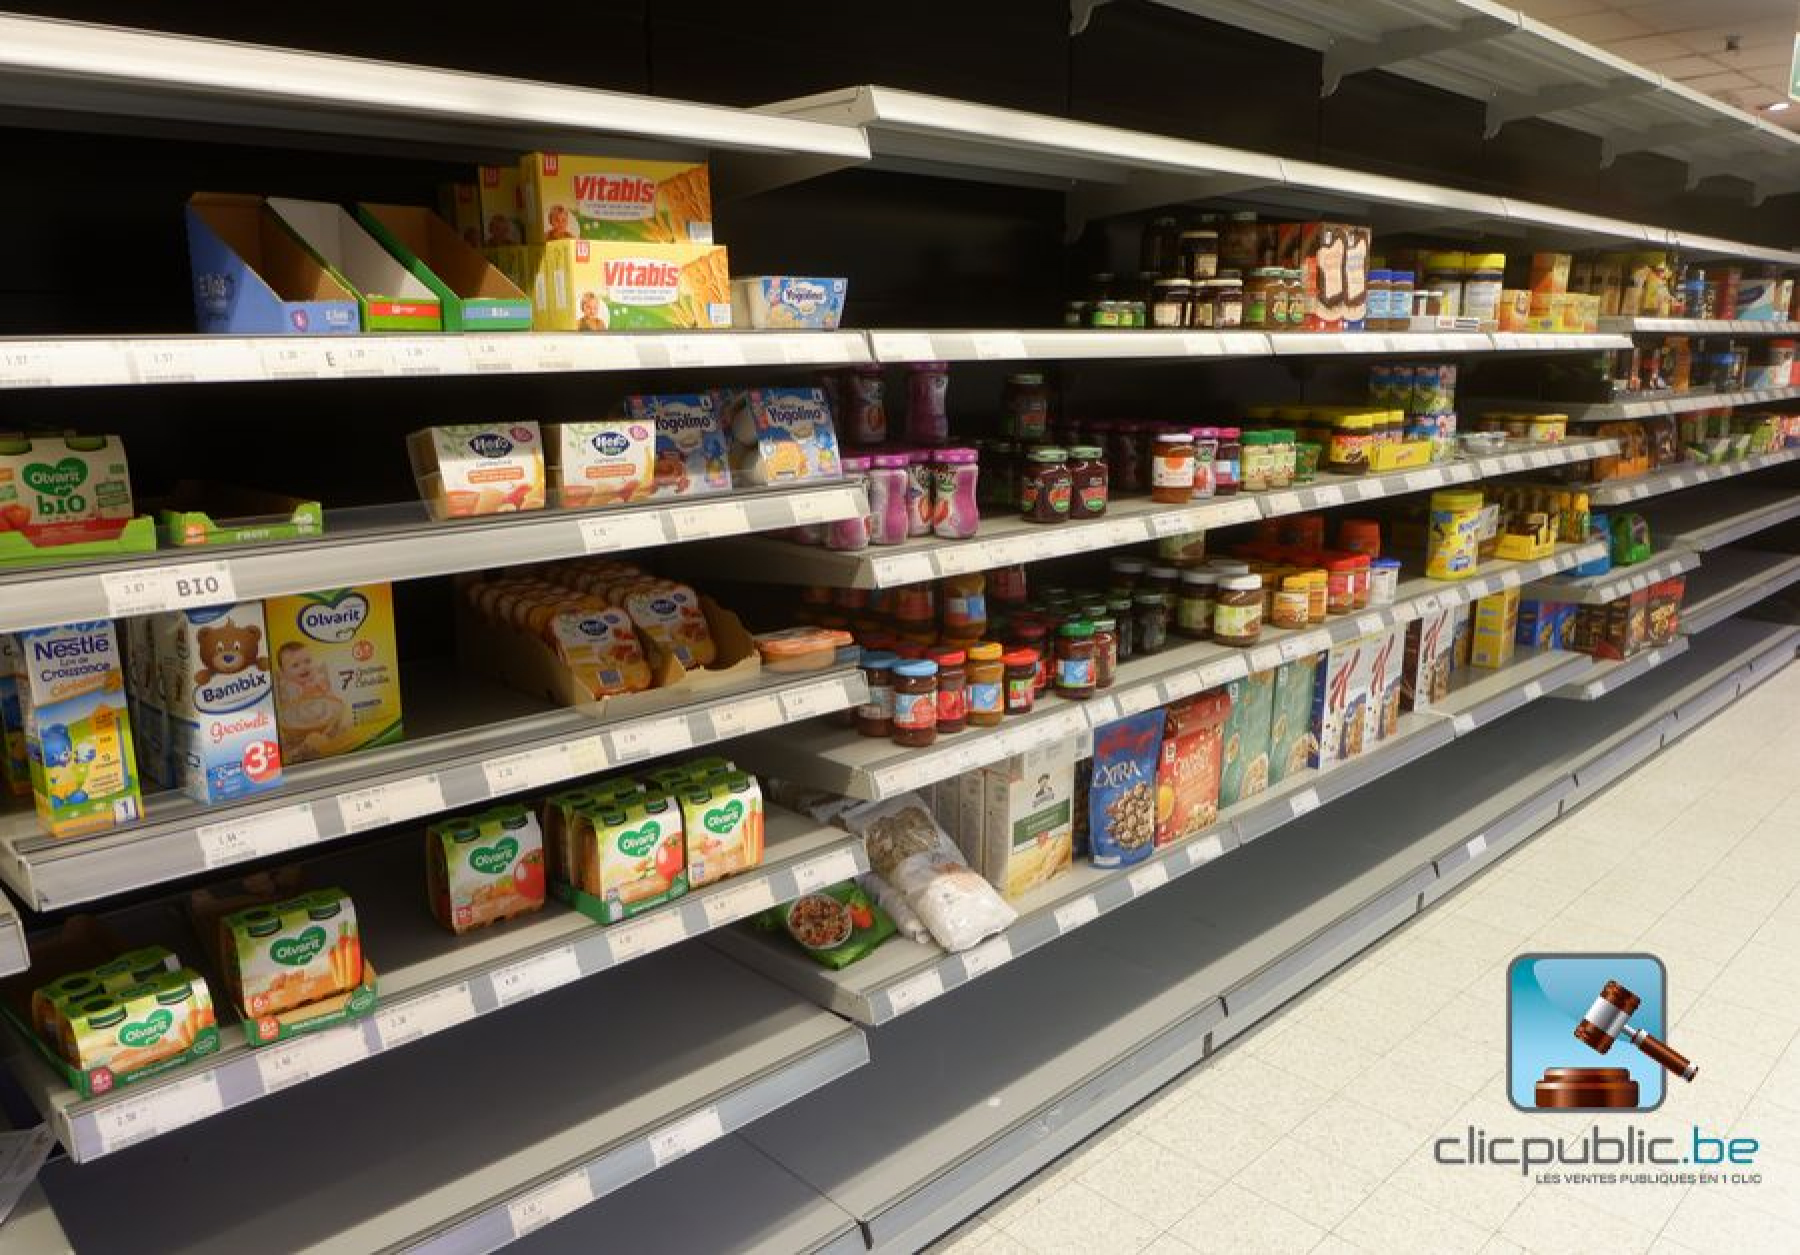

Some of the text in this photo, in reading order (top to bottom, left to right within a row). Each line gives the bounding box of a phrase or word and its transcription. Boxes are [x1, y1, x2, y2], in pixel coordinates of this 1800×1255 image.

[573, 175, 655, 202] Vitabis
[604, 261, 679, 287] Vitabis
[31, 470, 81, 485] Olvarit
[176, 576, 219, 597] BIO
[306, 608, 361, 627] Olvarit
[202, 673, 267, 702] Bambix
[276, 938, 321, 959] Olvarit
